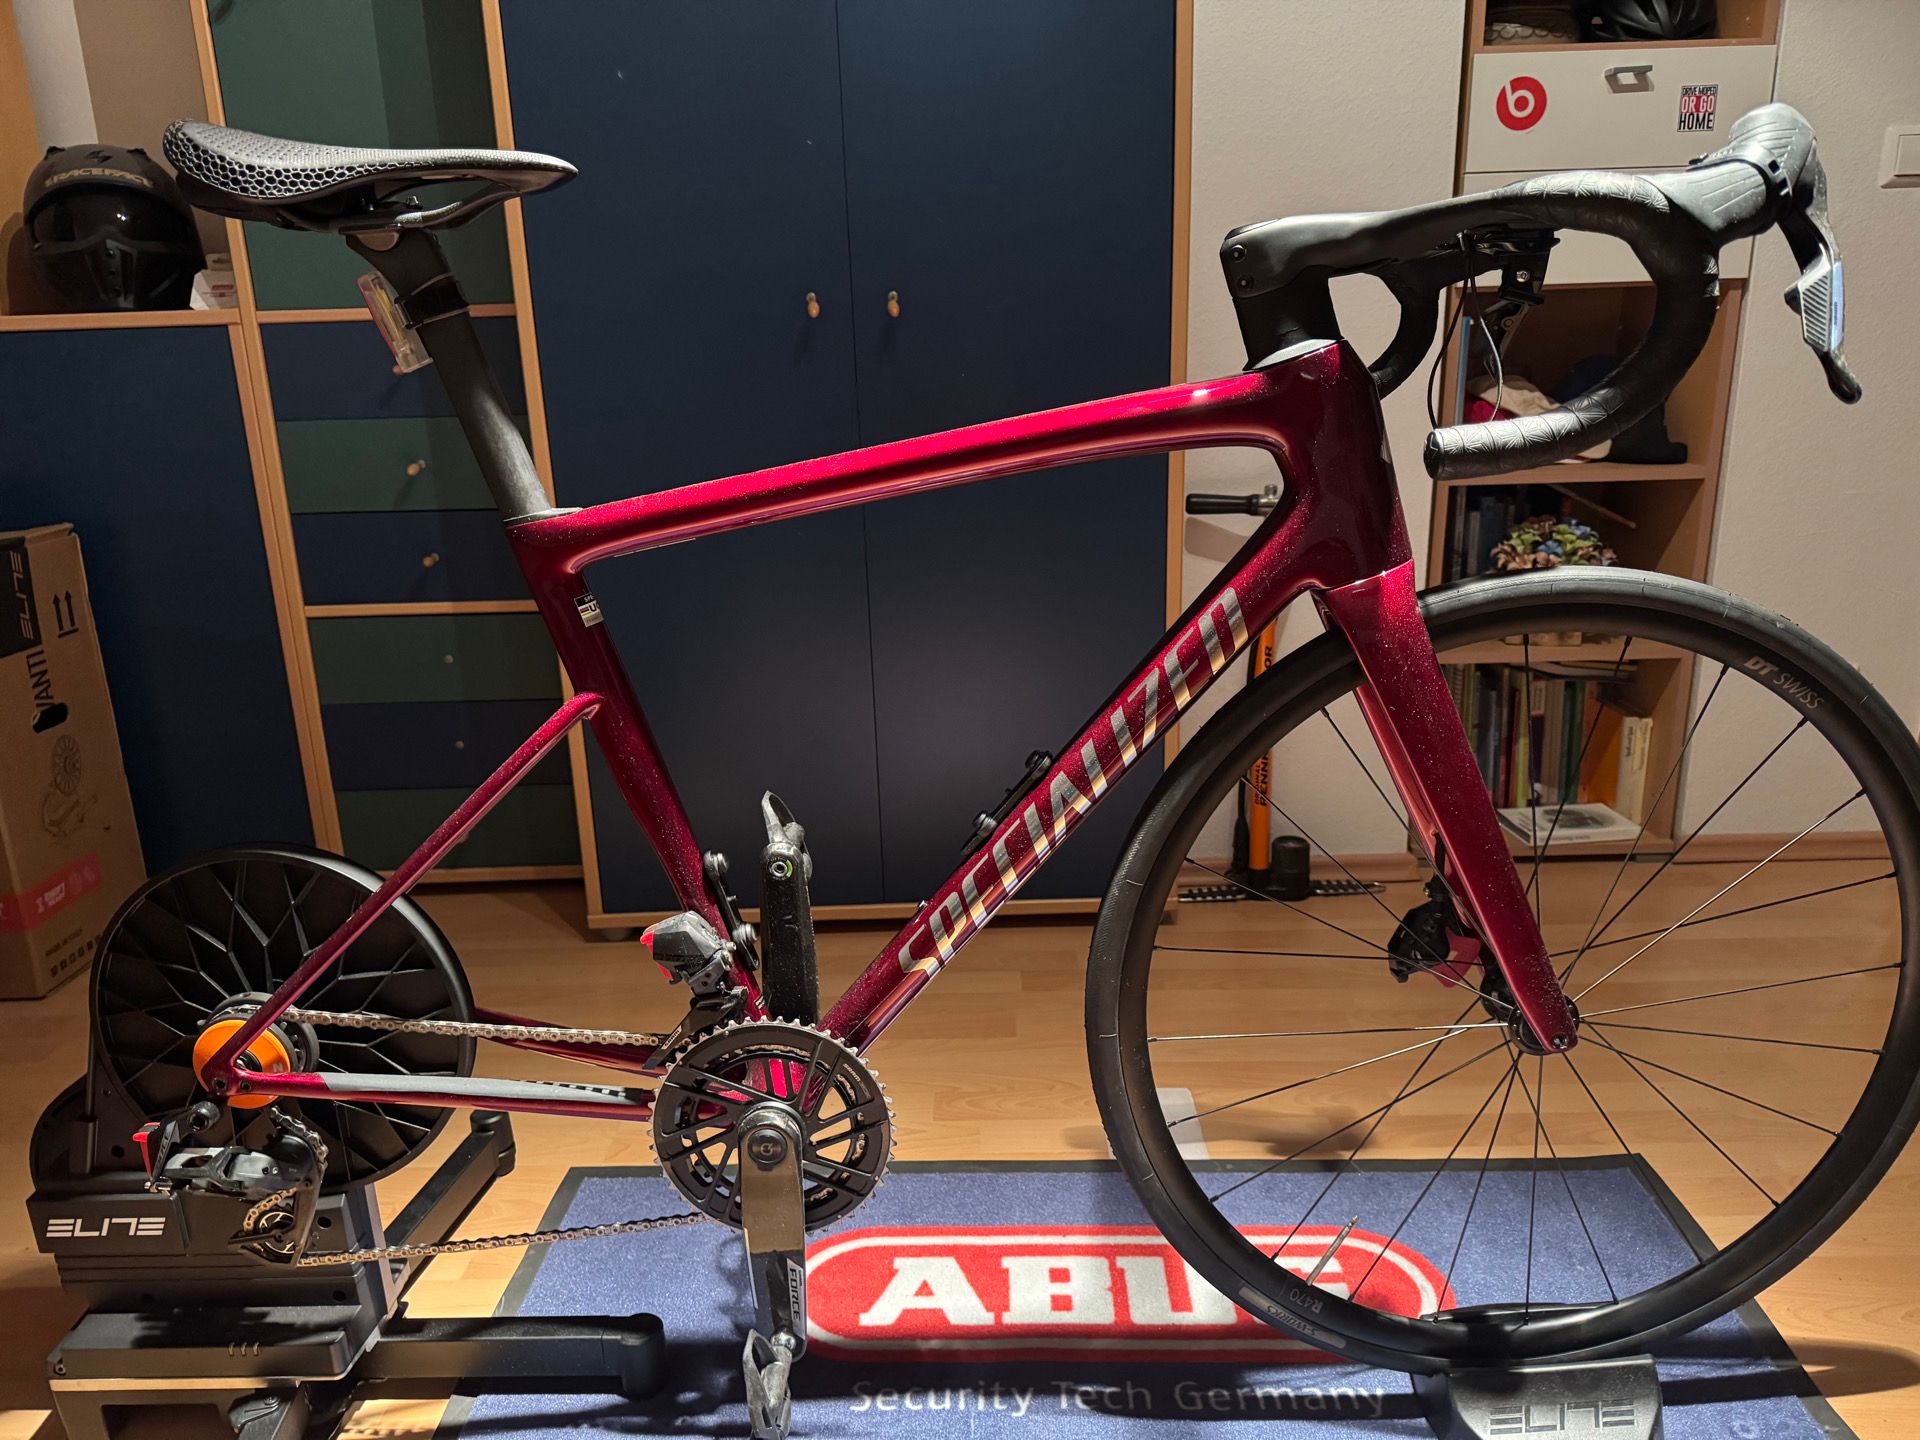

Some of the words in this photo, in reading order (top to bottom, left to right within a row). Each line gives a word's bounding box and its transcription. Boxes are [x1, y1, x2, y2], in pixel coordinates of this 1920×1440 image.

[1681, 96, 1697, 113] OR
[1699, 95, 1715, 112] GO
[1678, 112, 1714, 130] HOME
[1744, 656, 1780, 676] DT
[1773, 672, 1824, 709] SWISS
[45, 1216, 167, 1238] ELITE
[789, 1267, 801, 1321] FORCE
[1289, 1288, 1324, 1315] R470
[1266, 1304, 1319, 1336] S-WORKS
[849, 1380, 1034, 1418] Security
[1051, 1380, 1151, 1411] Tech
[1174, 1380, 1385, 1418] Germany
